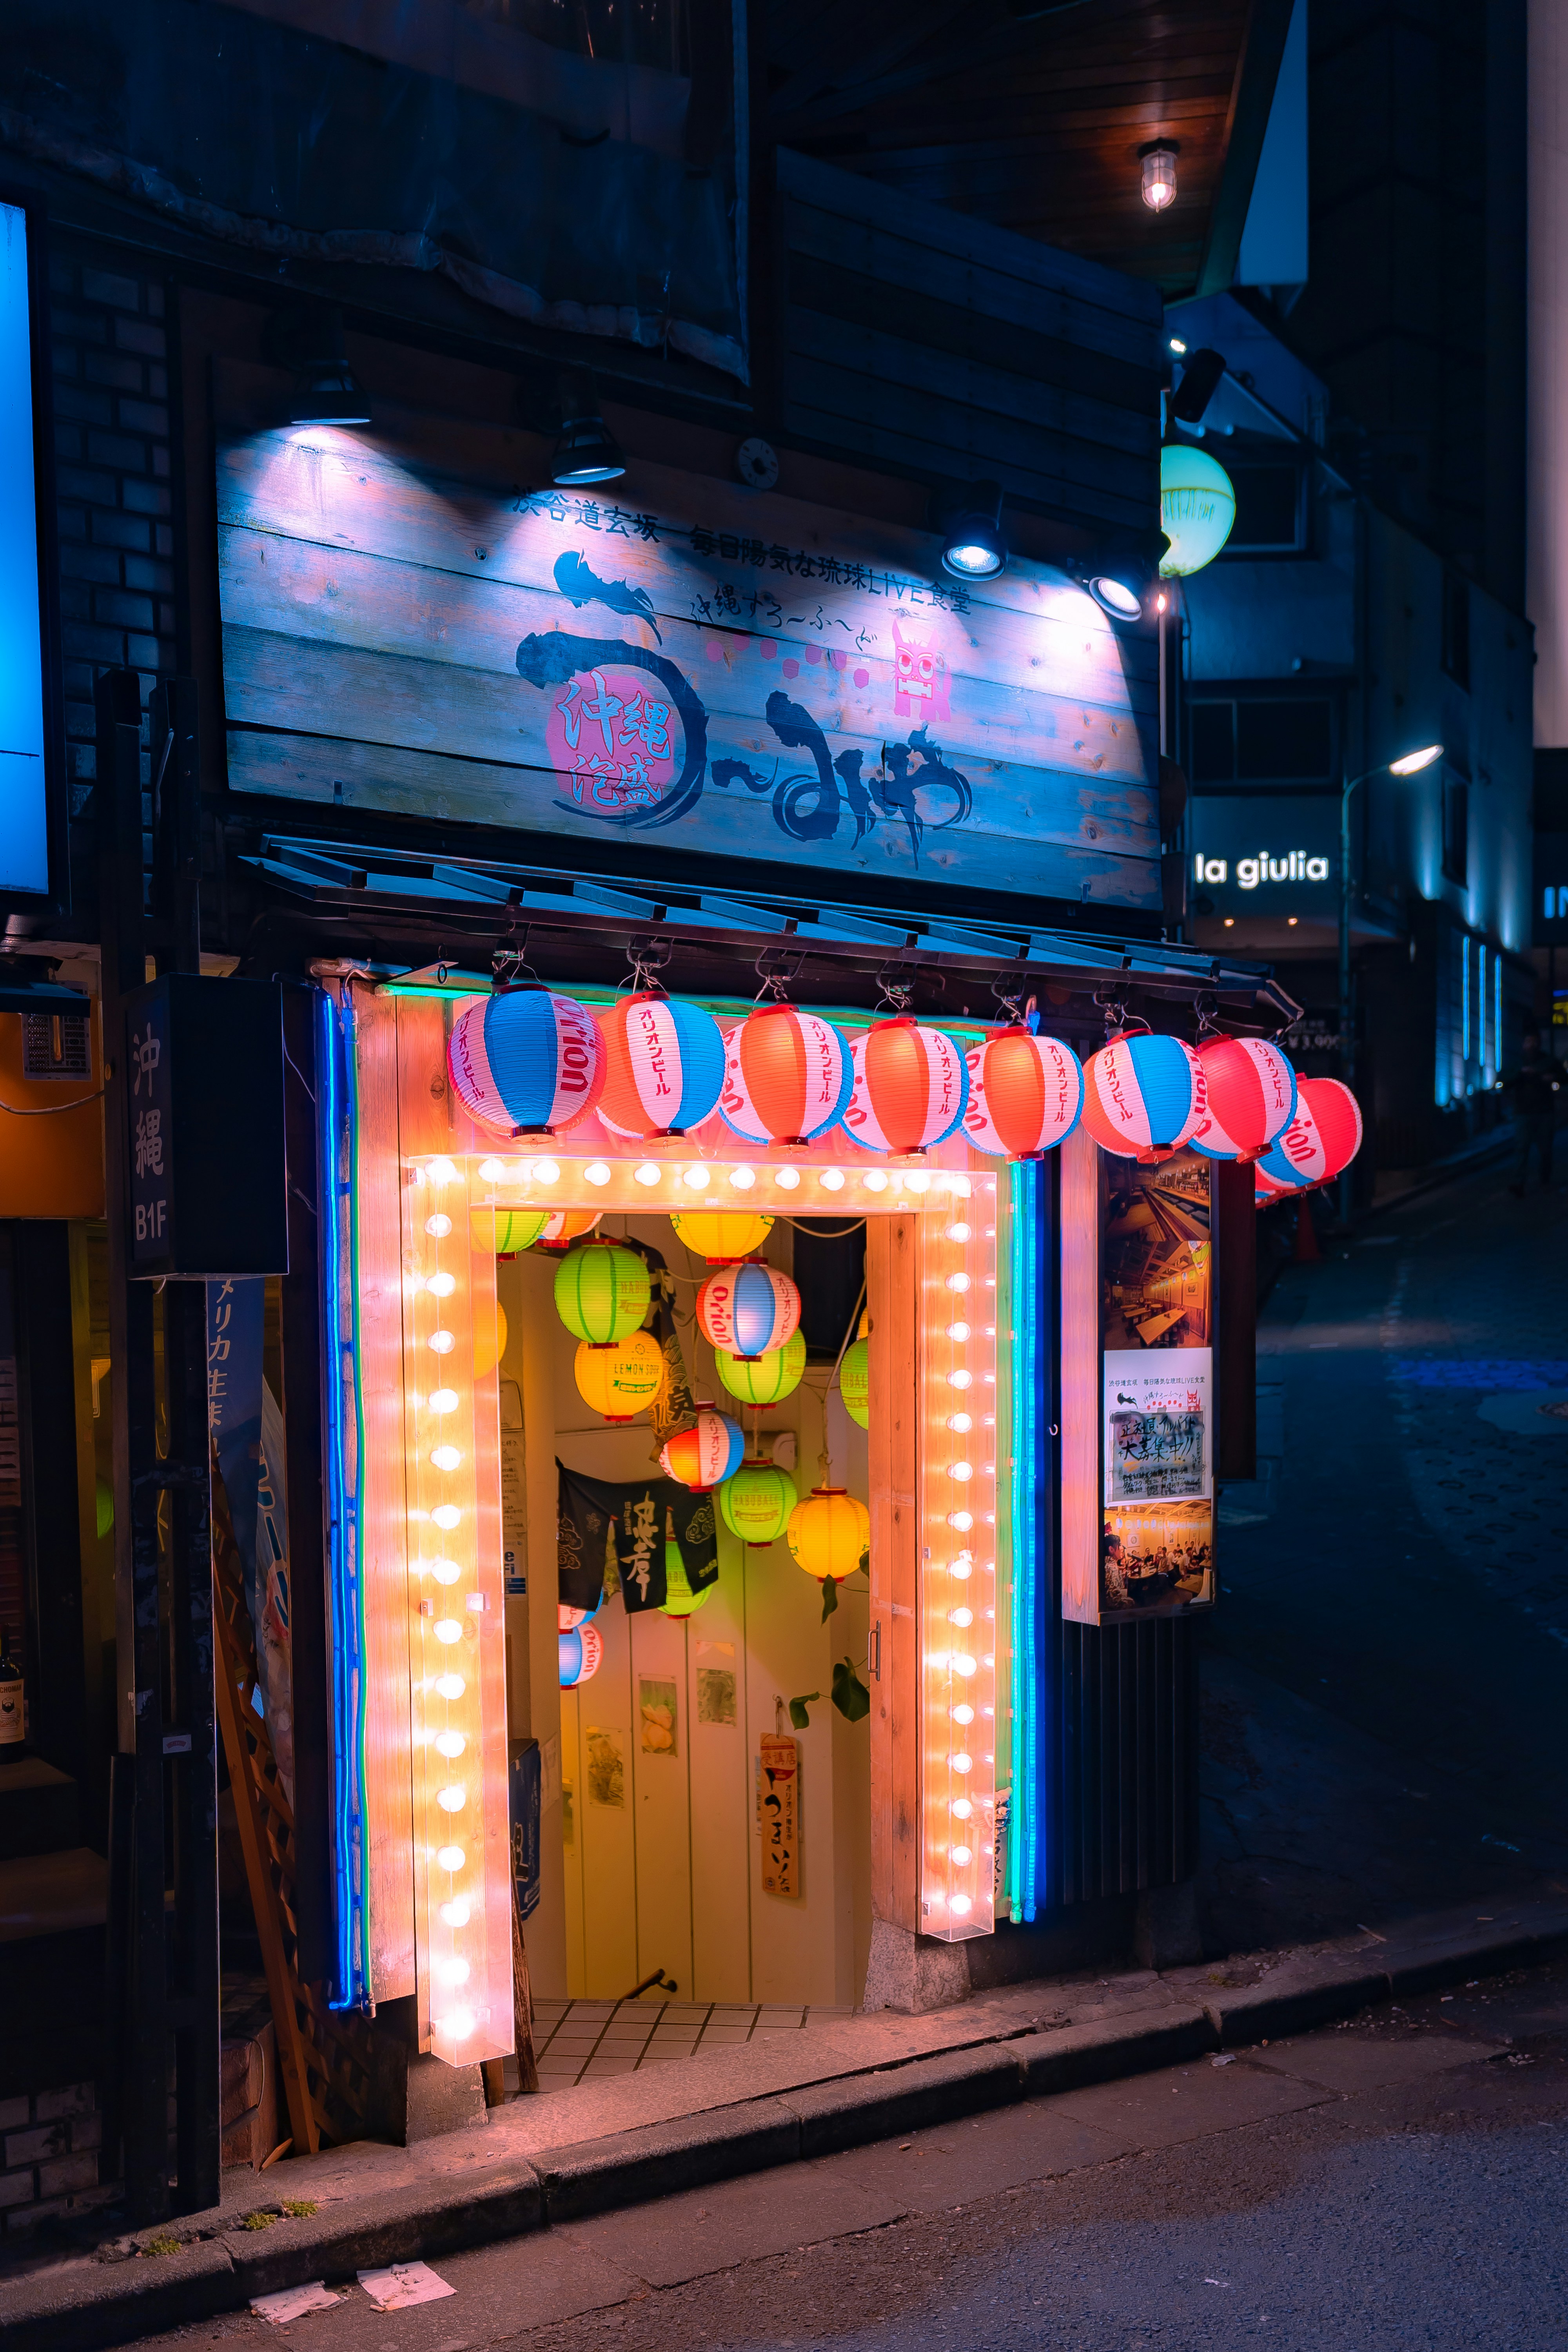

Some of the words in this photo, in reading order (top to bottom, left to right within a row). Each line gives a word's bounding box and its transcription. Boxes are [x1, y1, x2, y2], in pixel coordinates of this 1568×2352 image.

[512, 485, 660, 543] 渋谷道玄坂
[555, 668, 671, 761] 沖縄
[568, 752, 663, 808] 泡盛
[1195, 853, 1227, 883] la
[1237, 850, 1329, 889] giulia
[639, 1009, 671, 1096] オリオンビール
[812, 1020, 831, 1103] オリオンビール
[930, 1034, 951, 1114] オリオンビール
[1047, 1045, 1067, 1122] オリオンビール
[1253, 1041, 1285, 1109] オリオンビール
[134, 1022, 163, 1179] 沖縄
[1103, 1049, 1133, 1122] オリオンビール
[136, 1200, 166, 1241] B1F
[710, 1286, 732, 1344] Orion
[207, 1278, 234, 1457] メリカ生ま
[614, 1363, 643, 1375] LEMON
[1108, 1379, 1138, 1387] 渋谷道玄坂
[707, 1417, 720, 1478] オリオンビール
[583, 1630, 599, 1673] Orion
